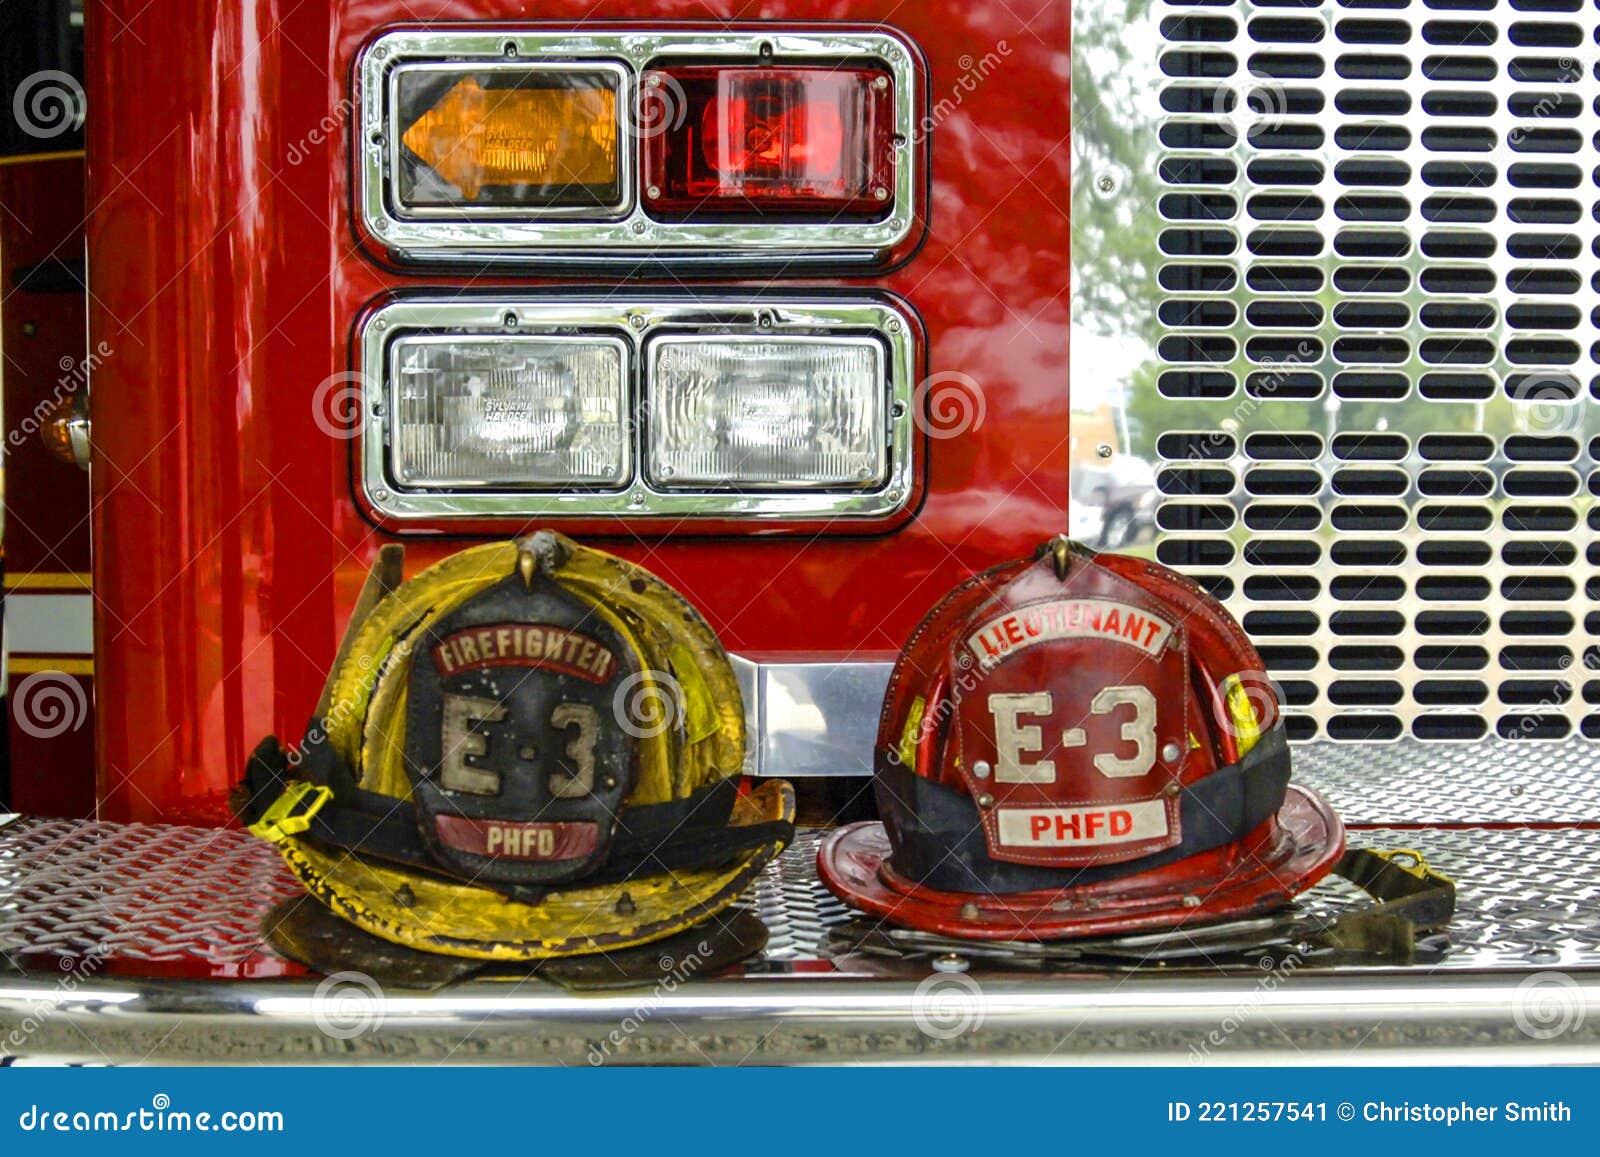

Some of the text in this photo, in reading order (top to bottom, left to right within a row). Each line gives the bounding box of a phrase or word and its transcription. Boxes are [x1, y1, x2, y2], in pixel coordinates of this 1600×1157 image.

[439, 628, 613, 677] FIREFIGHTER
[978, 603, 1161, 658] LIEUTENANT
[988, 685, 1157, 783] E-3
[486, 826, 555, 857] PHFD
[1030, 810, 1133, 841] PHFD
